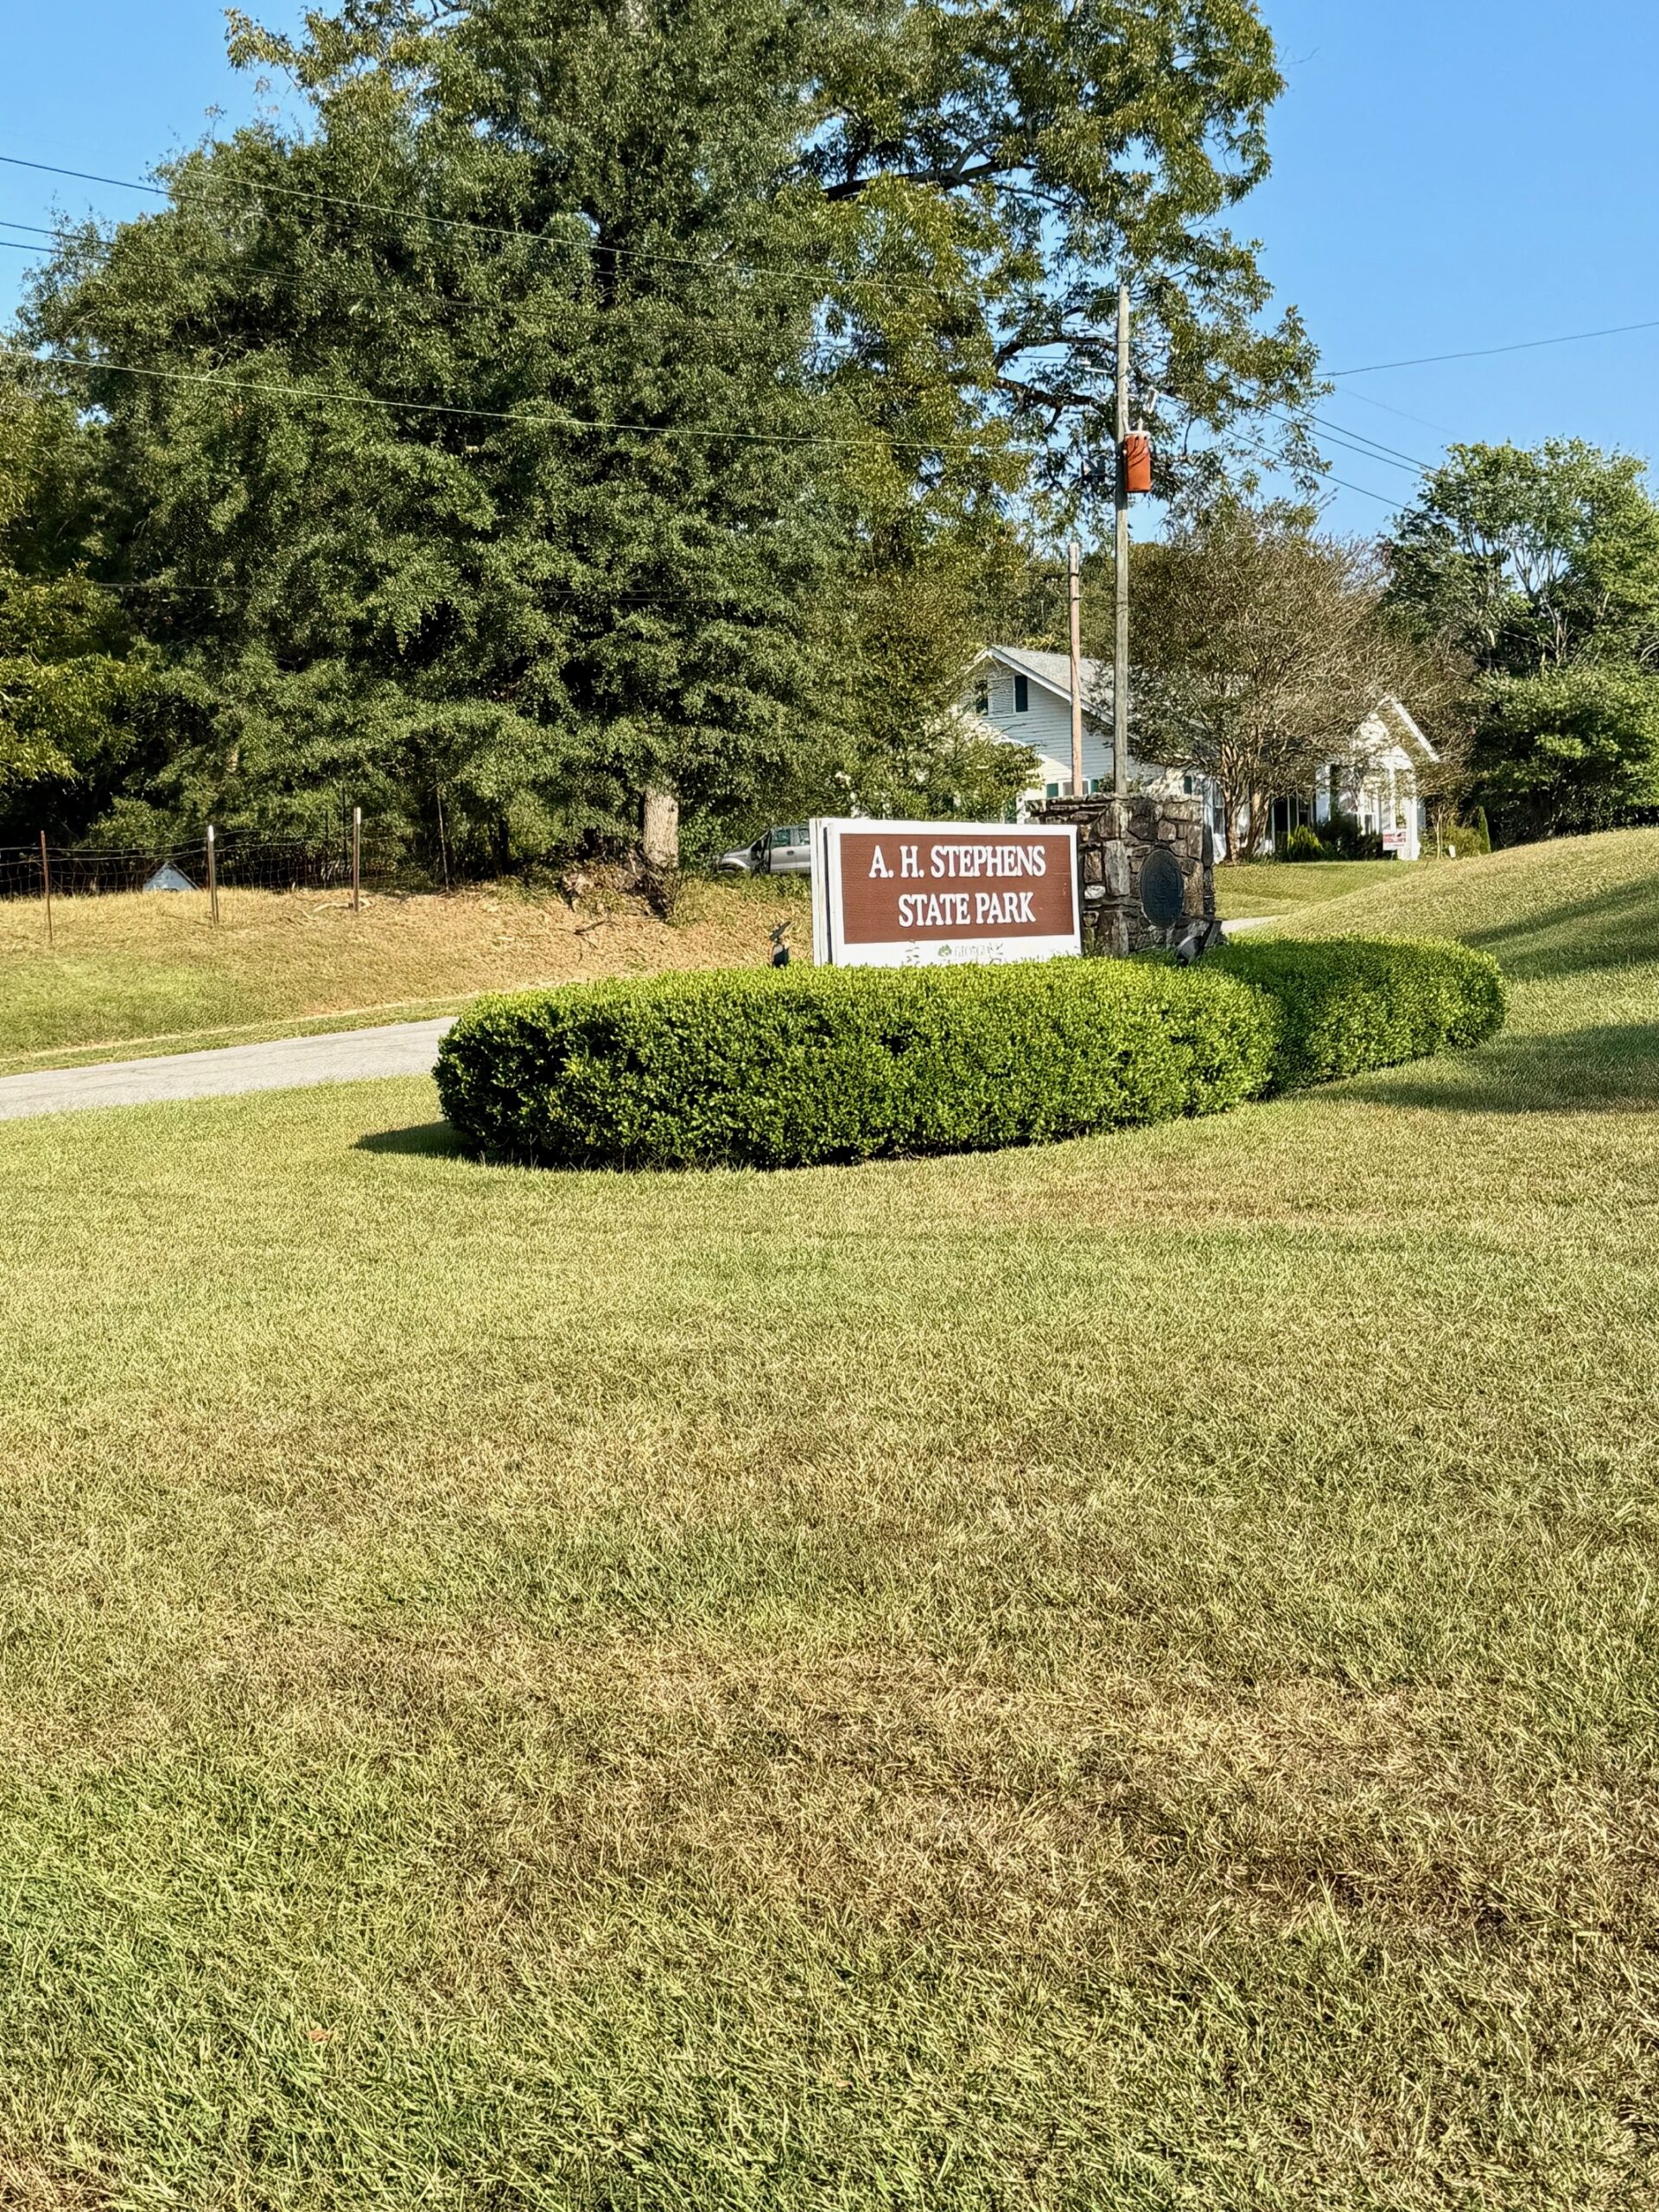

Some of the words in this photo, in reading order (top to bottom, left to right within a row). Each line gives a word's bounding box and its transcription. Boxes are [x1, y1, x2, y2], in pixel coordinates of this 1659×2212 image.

[868, 844, 894, 878] A.
[899, 845, 925, 878] H.
[930, 844, 1046, 878] STEPHENS
[898, 892, 970, 927] STATE
[975, 892, 1036, 925] PARK
